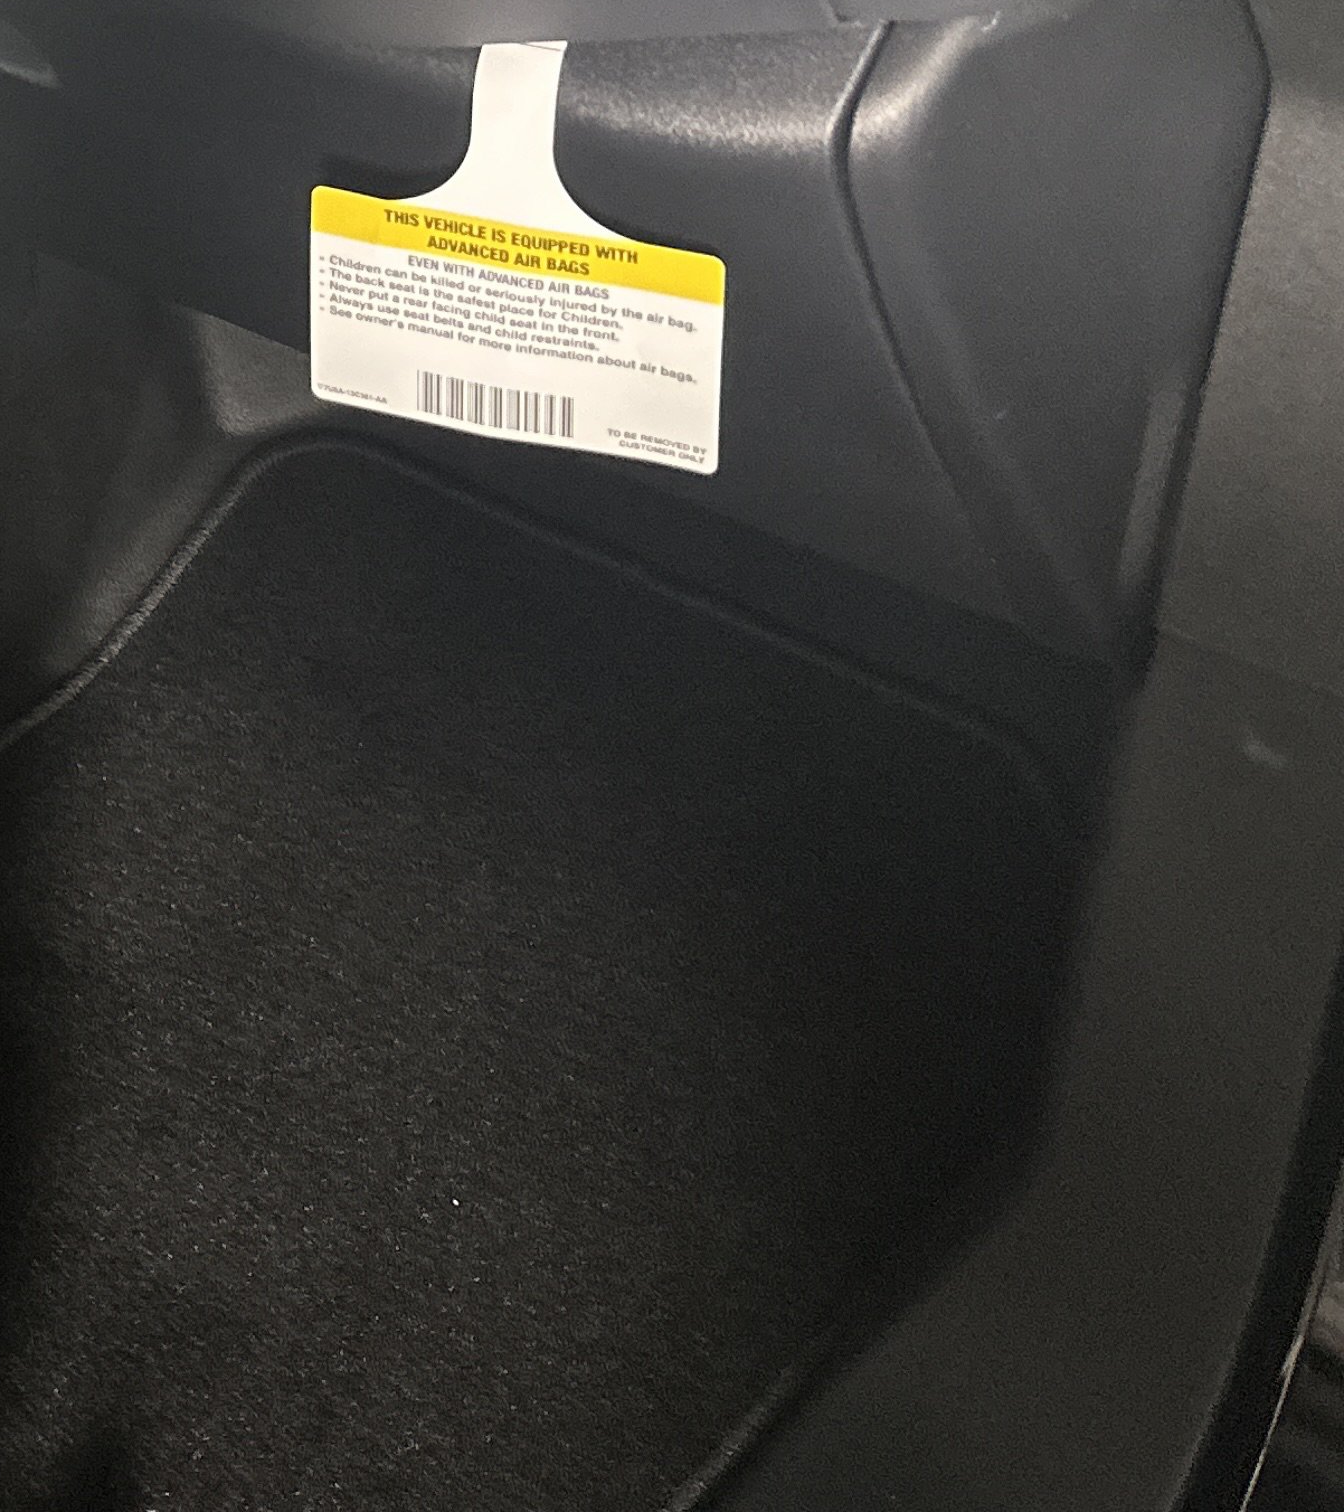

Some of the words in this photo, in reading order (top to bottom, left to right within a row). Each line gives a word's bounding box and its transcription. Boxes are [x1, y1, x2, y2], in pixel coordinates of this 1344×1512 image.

[384, 208, 420, 227] THIS
[424, 217, 486, 240] VEHICLE
[492, 228, 506, 244] IS
[511, 232, 590, 257] EQUIPPED
[595, 245, 639, 265] WITH
[427, 236, 509, 263] ADVANCED
[514, 251, 542, 270] AIR
[547, 257, 590, 276] BAGS
[329, 254, 382, 274] Children
[385, 267, 408, 279] can
[411, 272, 427, 283] be
[430, 274, 465, 290] killed
[468, 283, 482, 293] or
[485, 287, 546, 307] seriously
[549, 296, 597, 313] injured
[601, 304, 617, 317] by
[621, 308, 643, 320] the
[646, 313, 664, 324] air
[668, 315, 698, 333] bag.
[329, 267, 352, 281] The
[355, 274, 385, 288] back
[389, 281, 416, 294] seat
[419, 286, 430, 296] is
[433, 288, 454, 301] the
[457, 293, 496, 309] safest
[499, 303, 534, 317] place
[538, 308, 557, 319] for
[561, 311, 624, 330] Children.
[408, 255, 440, 272] EVEN
[443, 260, 475, 279] WITH
[478, 267, 544, 291] ADVANCED
[548, 280, 570, 294] AIR
[574, 284, 610, 300] BAGS
[329, 280, 365, 297] Never
[368, 290, 388, 302] put
[392, 295, 400, 303] a
[403, 297, 428, 308] rear
[431, 300, 471, 319] facing
[474, 309, 506, 325] child
[509, 318, 538, 330] seat
[541, 322, 554, 332] in
[558, 324, 579, 336] the
[583, 327, 620, 342] front.
[329, 293, 375, 311] Always
[377, 304, 400, 315] use
[403, 308, 430, 322] seat
[433, 313, 465, 328] belts
[468, 321, 492, 335] and
[494, 327, 528, 341] child
[531, 332, 600, 351] restraints.
[329, 305, 352, 319] See
[356, 312, 405, 329] owner's
[407, 322, 454, 339] manual
[457, 330, 476, 343] for
[479, 337, 512, 352] more
[516, 341, 594, 363] information
[597, 354, 636, 370] about
[639, 361, 657, 373] air
[660, 365, 698, 384] bags.
[607, 428, 621, 437] TO
[624, 432, 637, 440] BE
[641, 435, 690, 450] REMOVED
[692, 445, 707, 455] BY
[619, 440, 676, 456] CUSTOMER
[678, 452, 705, 464] ONLY
